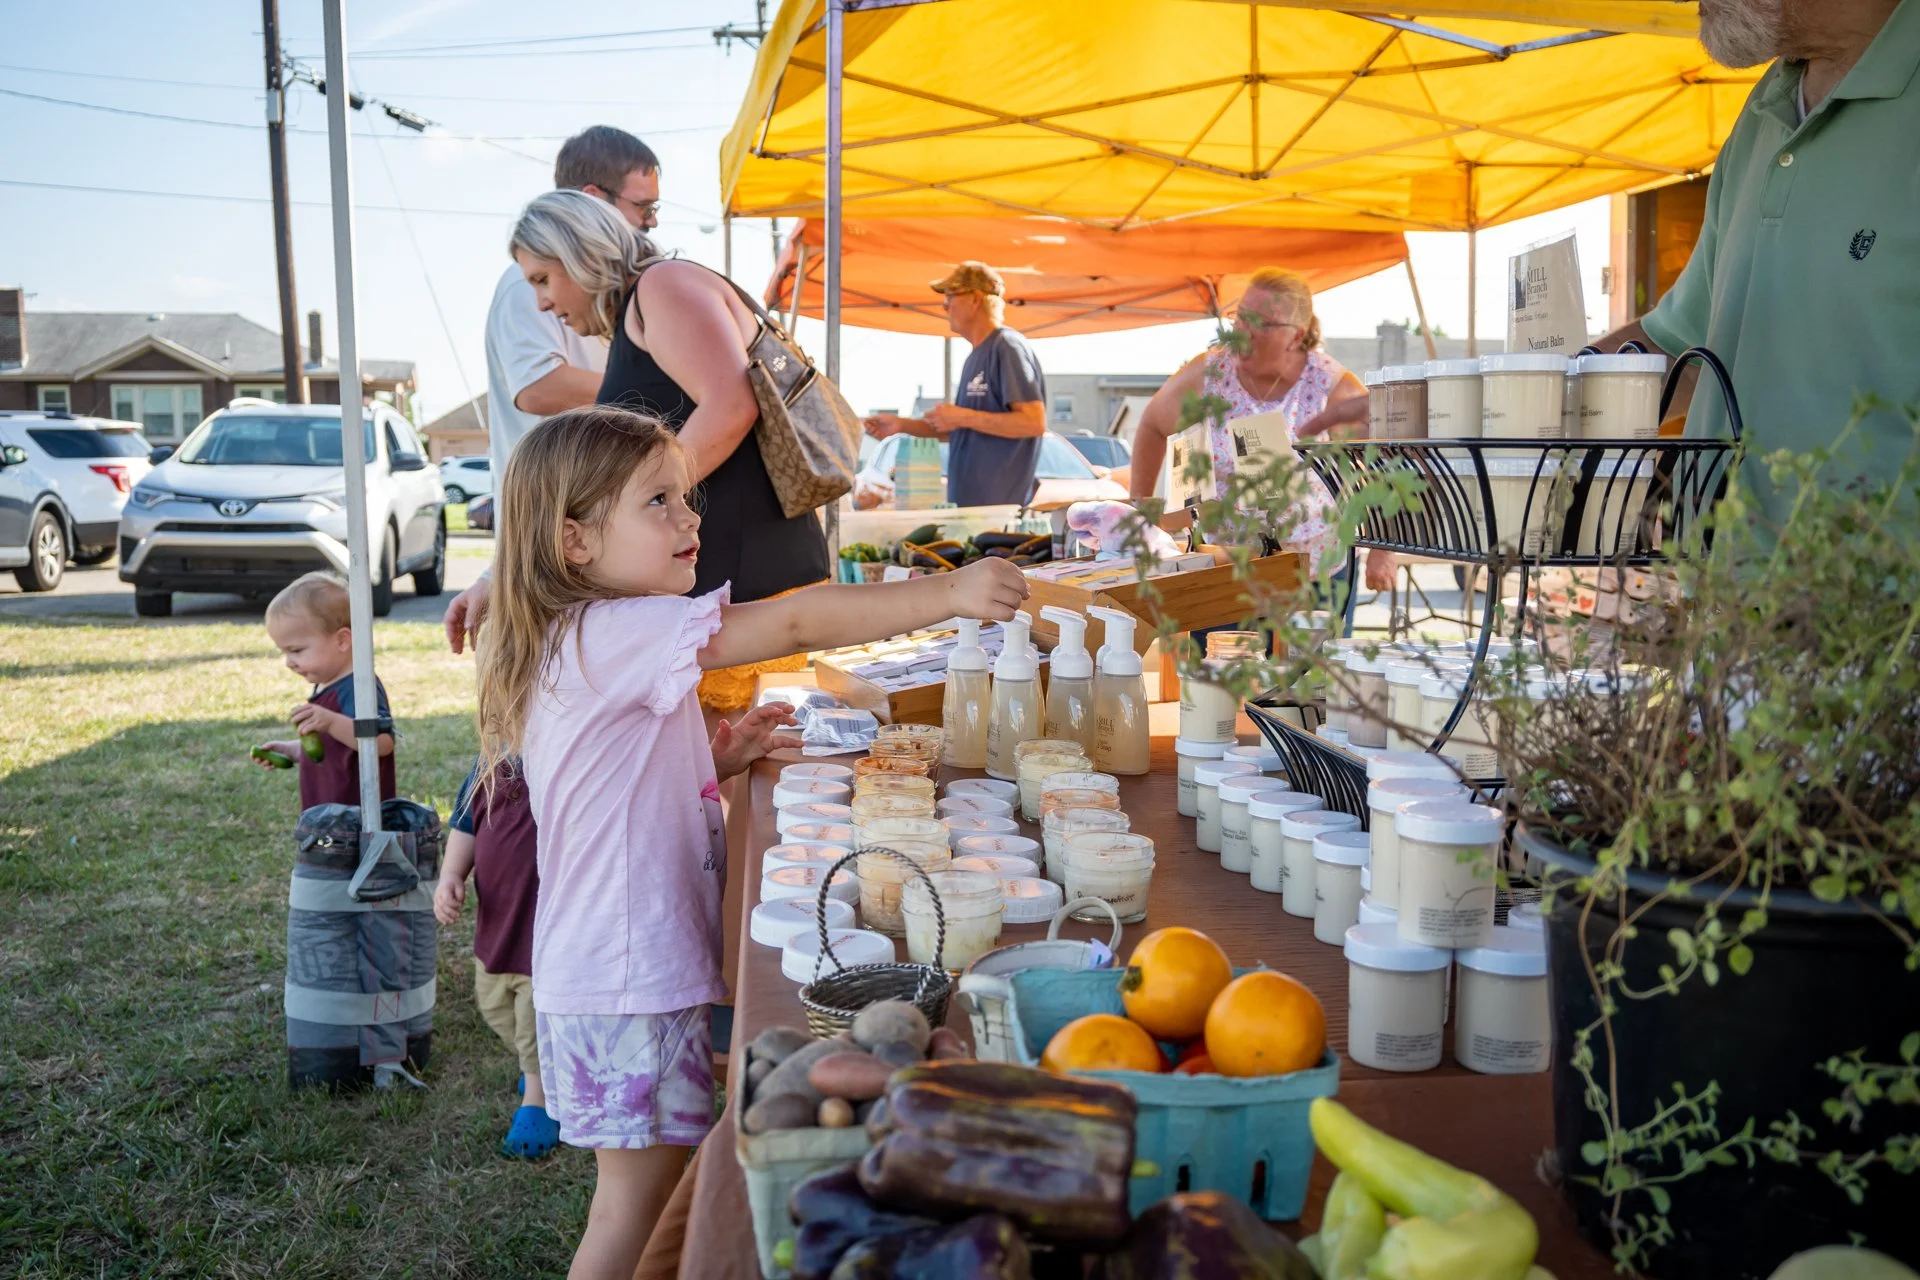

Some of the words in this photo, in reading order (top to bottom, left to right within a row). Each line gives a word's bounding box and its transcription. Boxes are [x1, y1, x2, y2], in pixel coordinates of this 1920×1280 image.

[1527, 281, 1548, 295] Branch
[1528, 336, 1549, 351] Natural
[1550, 334, 1565, 348] Balm
